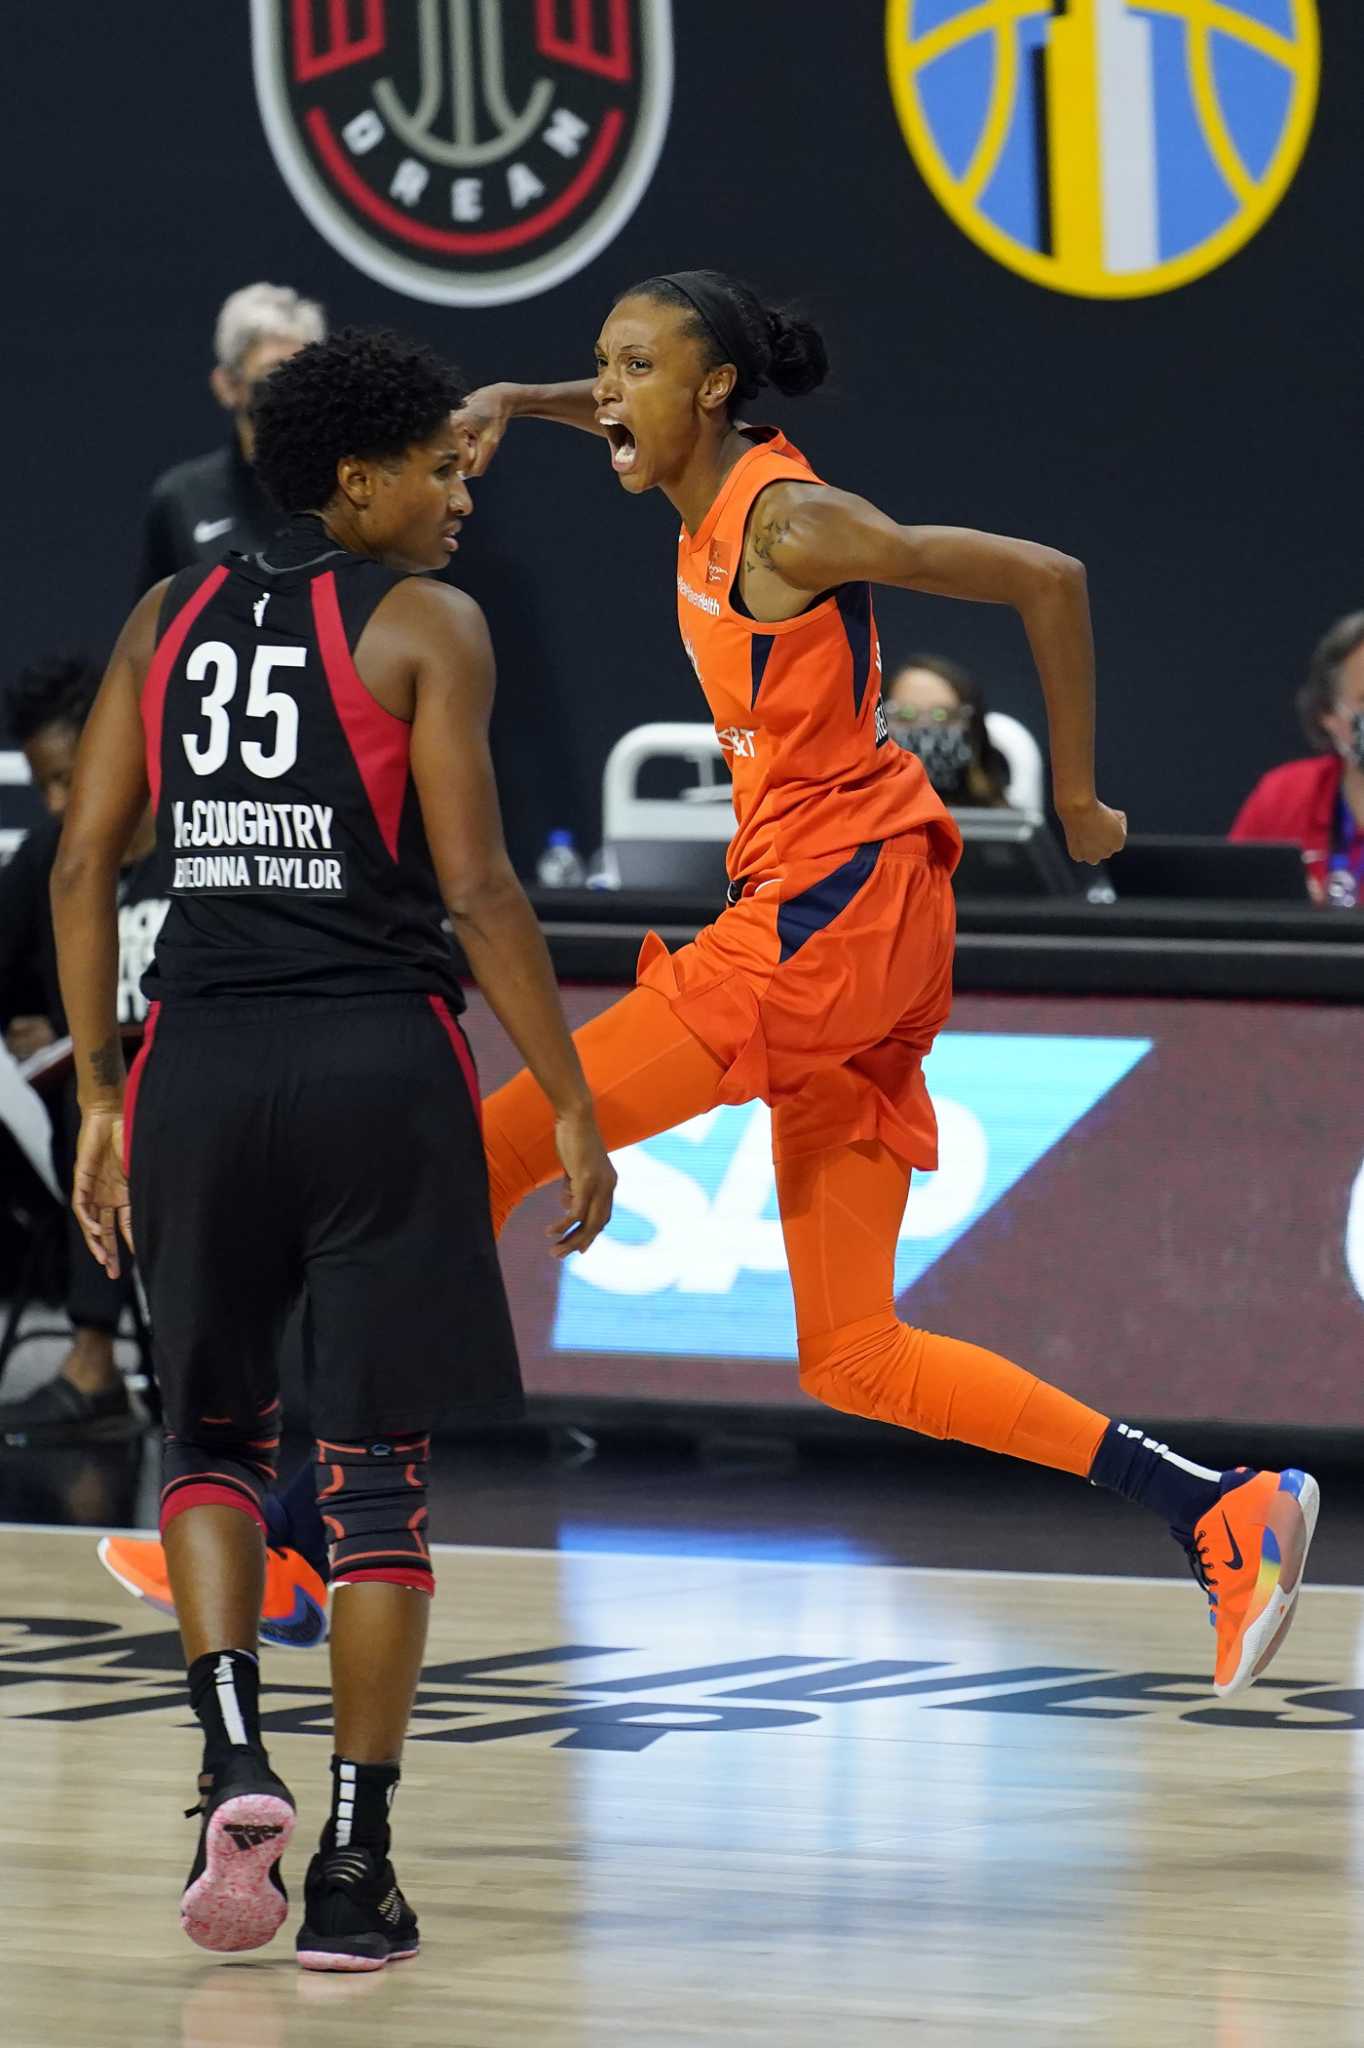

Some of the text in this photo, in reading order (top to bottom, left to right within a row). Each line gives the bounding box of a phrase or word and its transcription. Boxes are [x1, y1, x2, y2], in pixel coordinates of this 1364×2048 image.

[341, 107, 590, 223] DREAM
[181, 640, 308, 779] 35
[254, 855, 342, 889] TAYLOR
